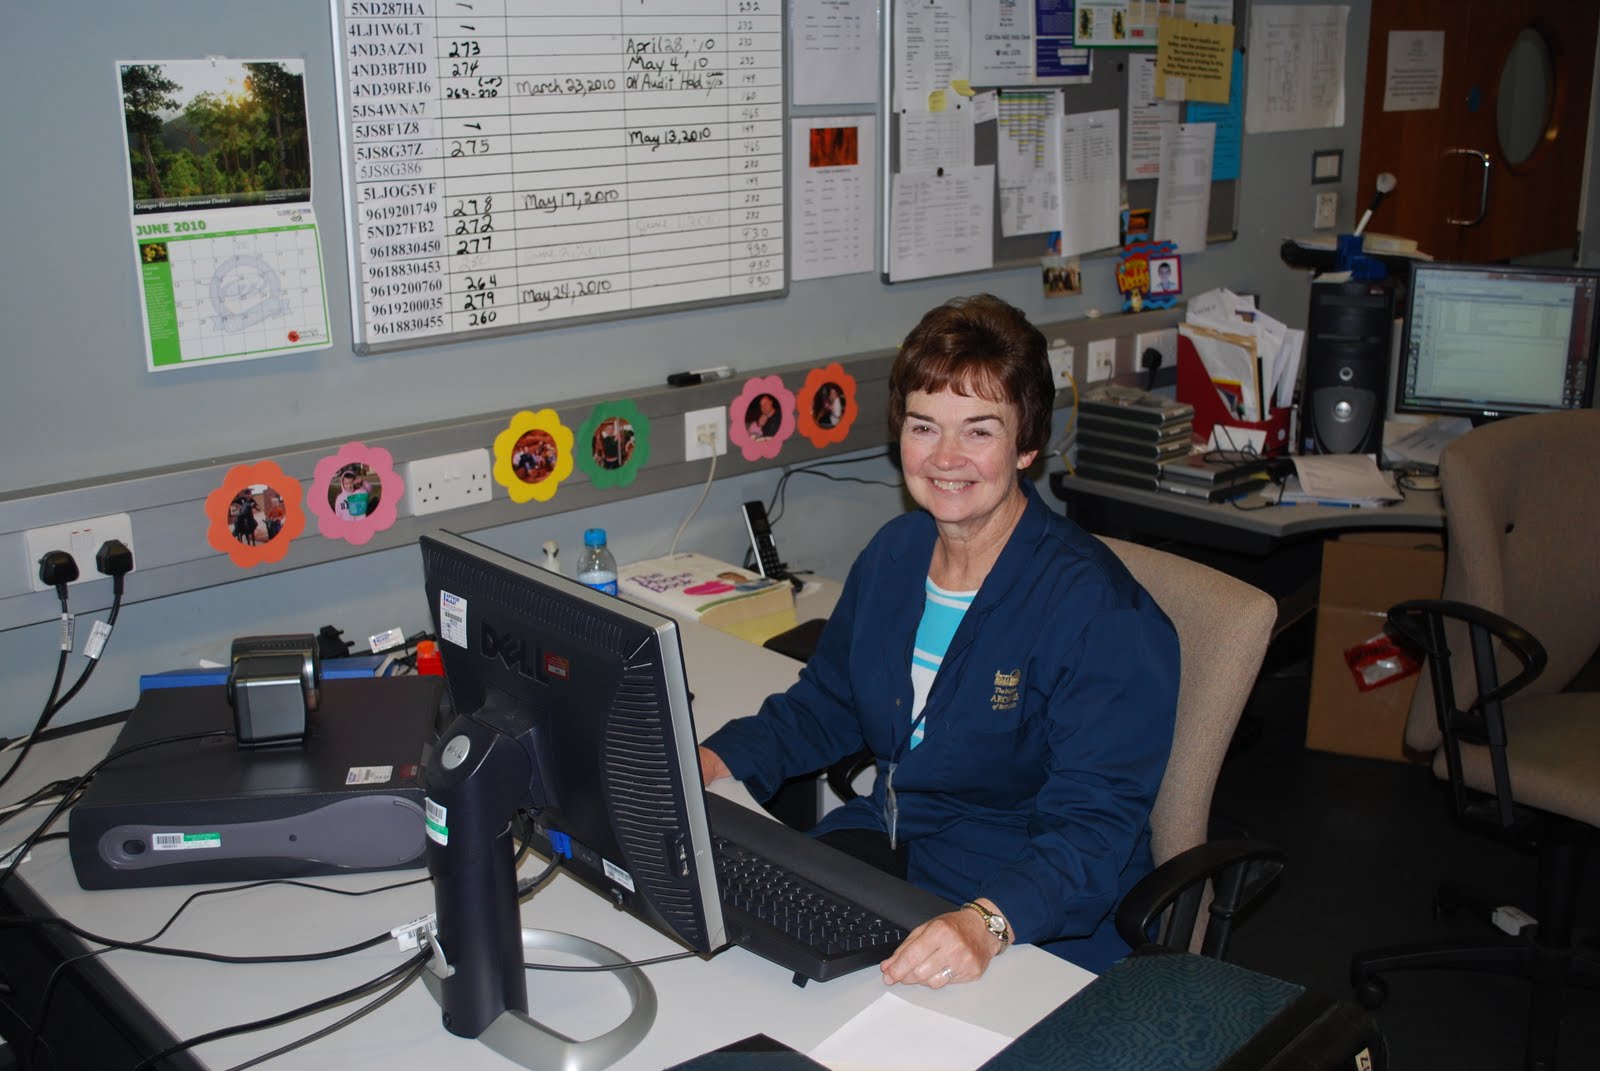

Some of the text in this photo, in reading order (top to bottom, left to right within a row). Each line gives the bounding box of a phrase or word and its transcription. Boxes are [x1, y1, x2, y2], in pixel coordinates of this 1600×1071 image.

[449, 41, 481, 58] 273
[452, 60, 479, 78] 274
[627, 56, 664, 76] May
[352, 102, 426, 118] 5JS4WNA7
[451, 139, 490, 157] 275
[628, 131, 660, 151] May
[357, 143, 424, 160] 5JS8G37Z
[361, 161, 422, 179] 5JS8G386
[366, 201, 438, 221] 9619201749
[453, 196, 493, 217] 278
[524, 193, 557, 213] May
[136, 223, 170, 236] JUNE
[173, 220, 207, 233] 2010
[367, 220, 435, 239] 5ND27FB2
[455, 214, 494, 235] 272
[370, 240, 441, 258] 9618830450
[456, 236, 492, 255] 277
[369, 261, 441, 278] 9618830453
[370, 279, 442, 297] 9619200760
[464, 274, 498, 290] 264
[372, 298, 443, 316] 9619200035
[464, 292, 495, 310] 279
[523, 288, 550, 311] May
[373, 316, 444, 335] 9618830455
[469, 311, 497, 326] 260
